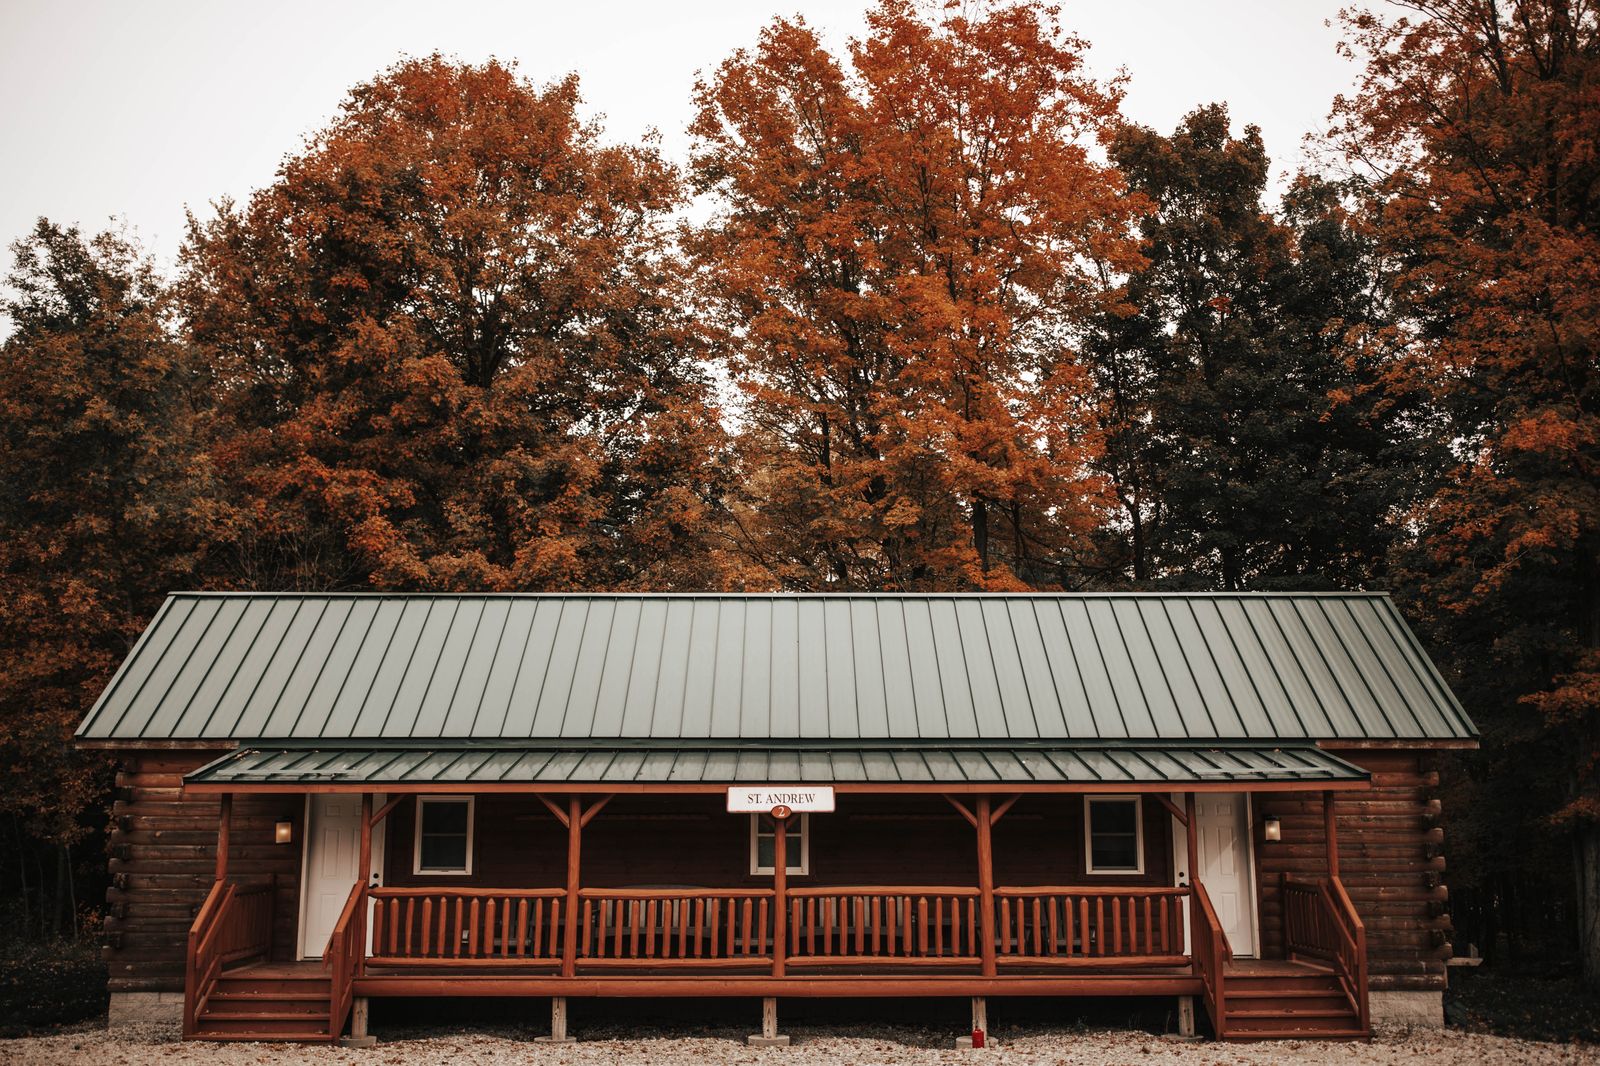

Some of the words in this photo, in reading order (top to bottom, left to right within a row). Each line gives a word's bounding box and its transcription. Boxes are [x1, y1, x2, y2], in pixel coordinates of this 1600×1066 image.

[747, 793, 762, 804] ST.
[766, 793, 816, 804] ANDREW
[778, 806, 785, 817] 2
